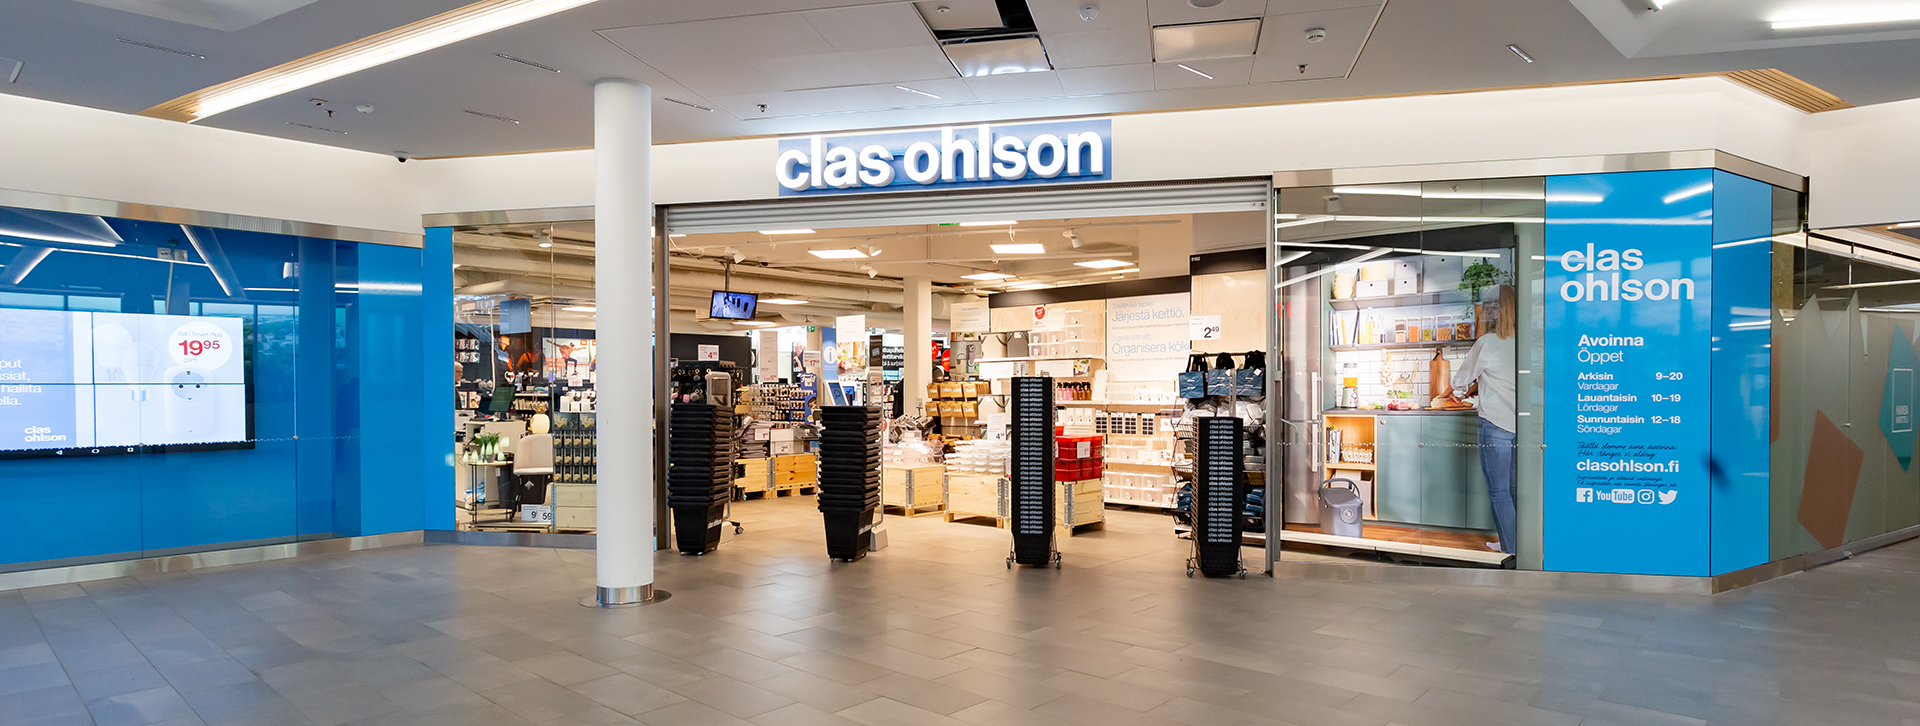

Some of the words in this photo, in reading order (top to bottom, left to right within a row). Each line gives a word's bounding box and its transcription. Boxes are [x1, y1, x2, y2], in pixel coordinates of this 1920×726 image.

[775, 135, 896, 191] clas
[904, 124, 1104, 185] ohlson
[1561, 243, 1644, 272] clas
[1560, 272, 1694, 302] ohlson
[1112, 308, 1150, 323] Järjestä
[1152, 307, 1184, 319] keittiö.
[1578, 334, 1644, 346] Avoinna
[1112, 342, 1166, 356] Organisera
[1578, 347, 1624, 365] Öppet
[1578, 372, 1614, 380] Arkisin
[1656, 372, 1683, 380] 9–20
[1577, 382, 1619, 392] Vardagar
[1578, 394, 1637, 402] Lauantaisin
[1651, 394, 1681, 402] 10–19
[1578, 404, 1619, 414] Lördagar
[1577, 415, 1644, 424] Sunnuntaisin
[24, 426, 51, 434] clas
[1577, 425, 1622, 435] Söndagar
[24, 433, 66, 442] ohlson
[1576, 459, 1679, 472] clasohlson.fi
[1596, 490, 1634, 503] YouTube
